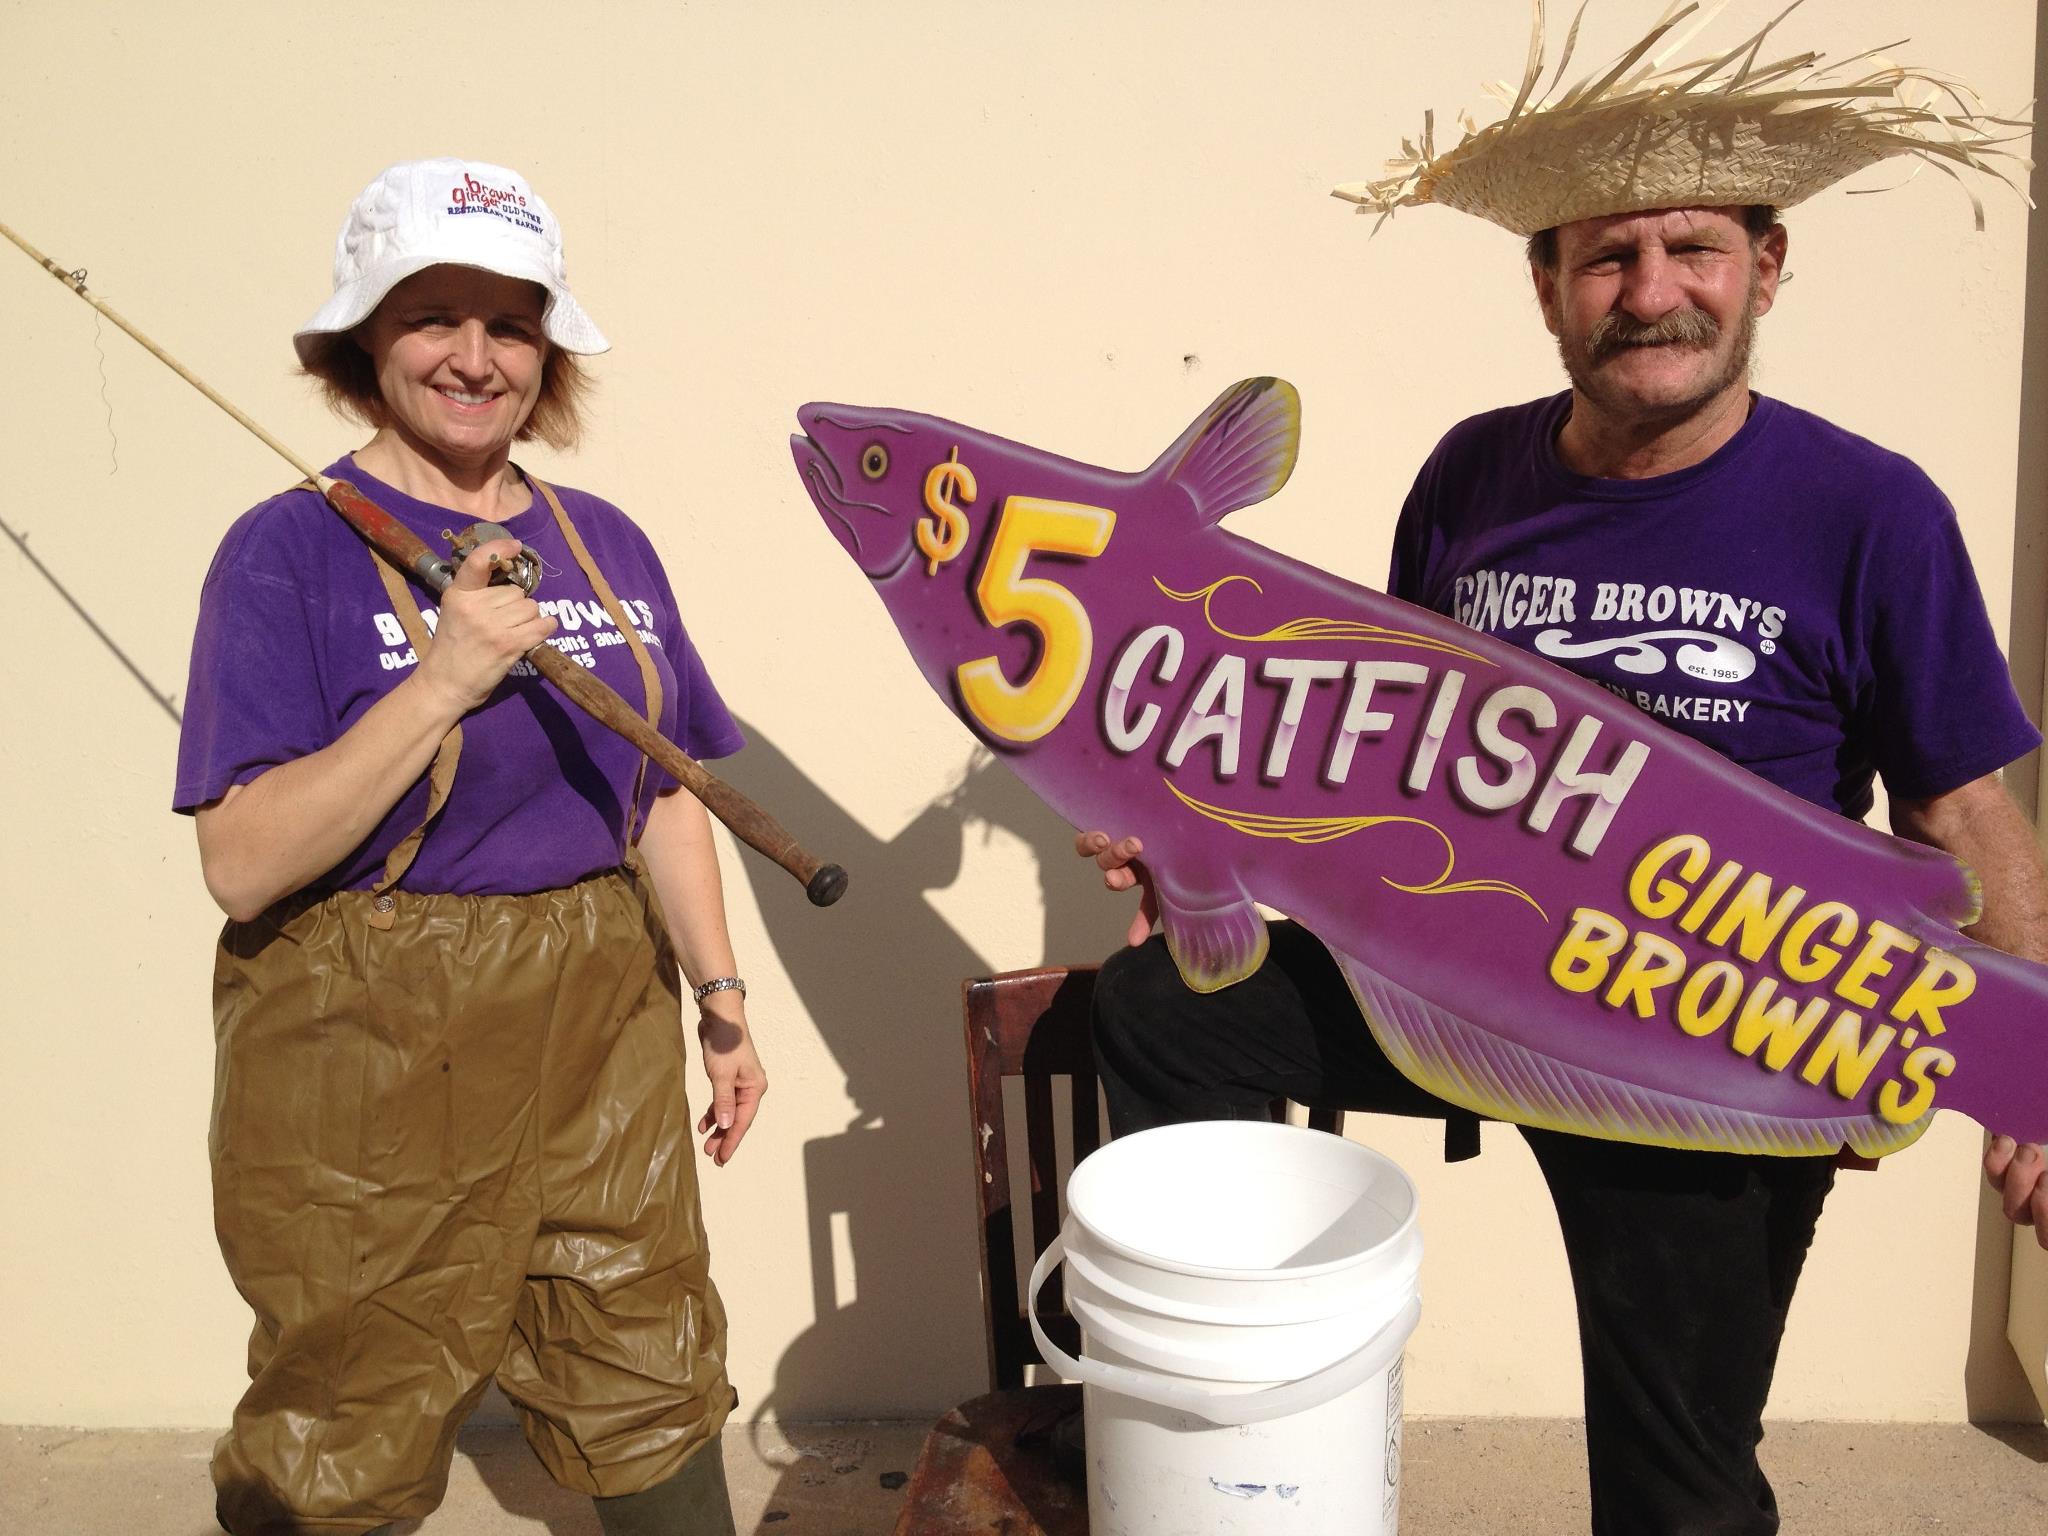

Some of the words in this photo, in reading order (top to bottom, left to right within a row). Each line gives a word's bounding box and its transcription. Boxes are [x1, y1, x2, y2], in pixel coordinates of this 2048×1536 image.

[453, 188, 501, 208] ginger
[464, 173, 526, 207] brown's
[1453, 569, 1577, 633] GINGER
[1591, 583, 1787, 638] BROWN'S
[1687, 663, 1708, 676] est.
[1712, 668, 1739, 679] 1985
[1636, 690, 1752, 723] BAKERY
[1104, 625, 1651, 858] CATFISH
[1629, 834, 1977, 1037] GINGER
[1549, 906, 1957, 1125] BROWN'S
